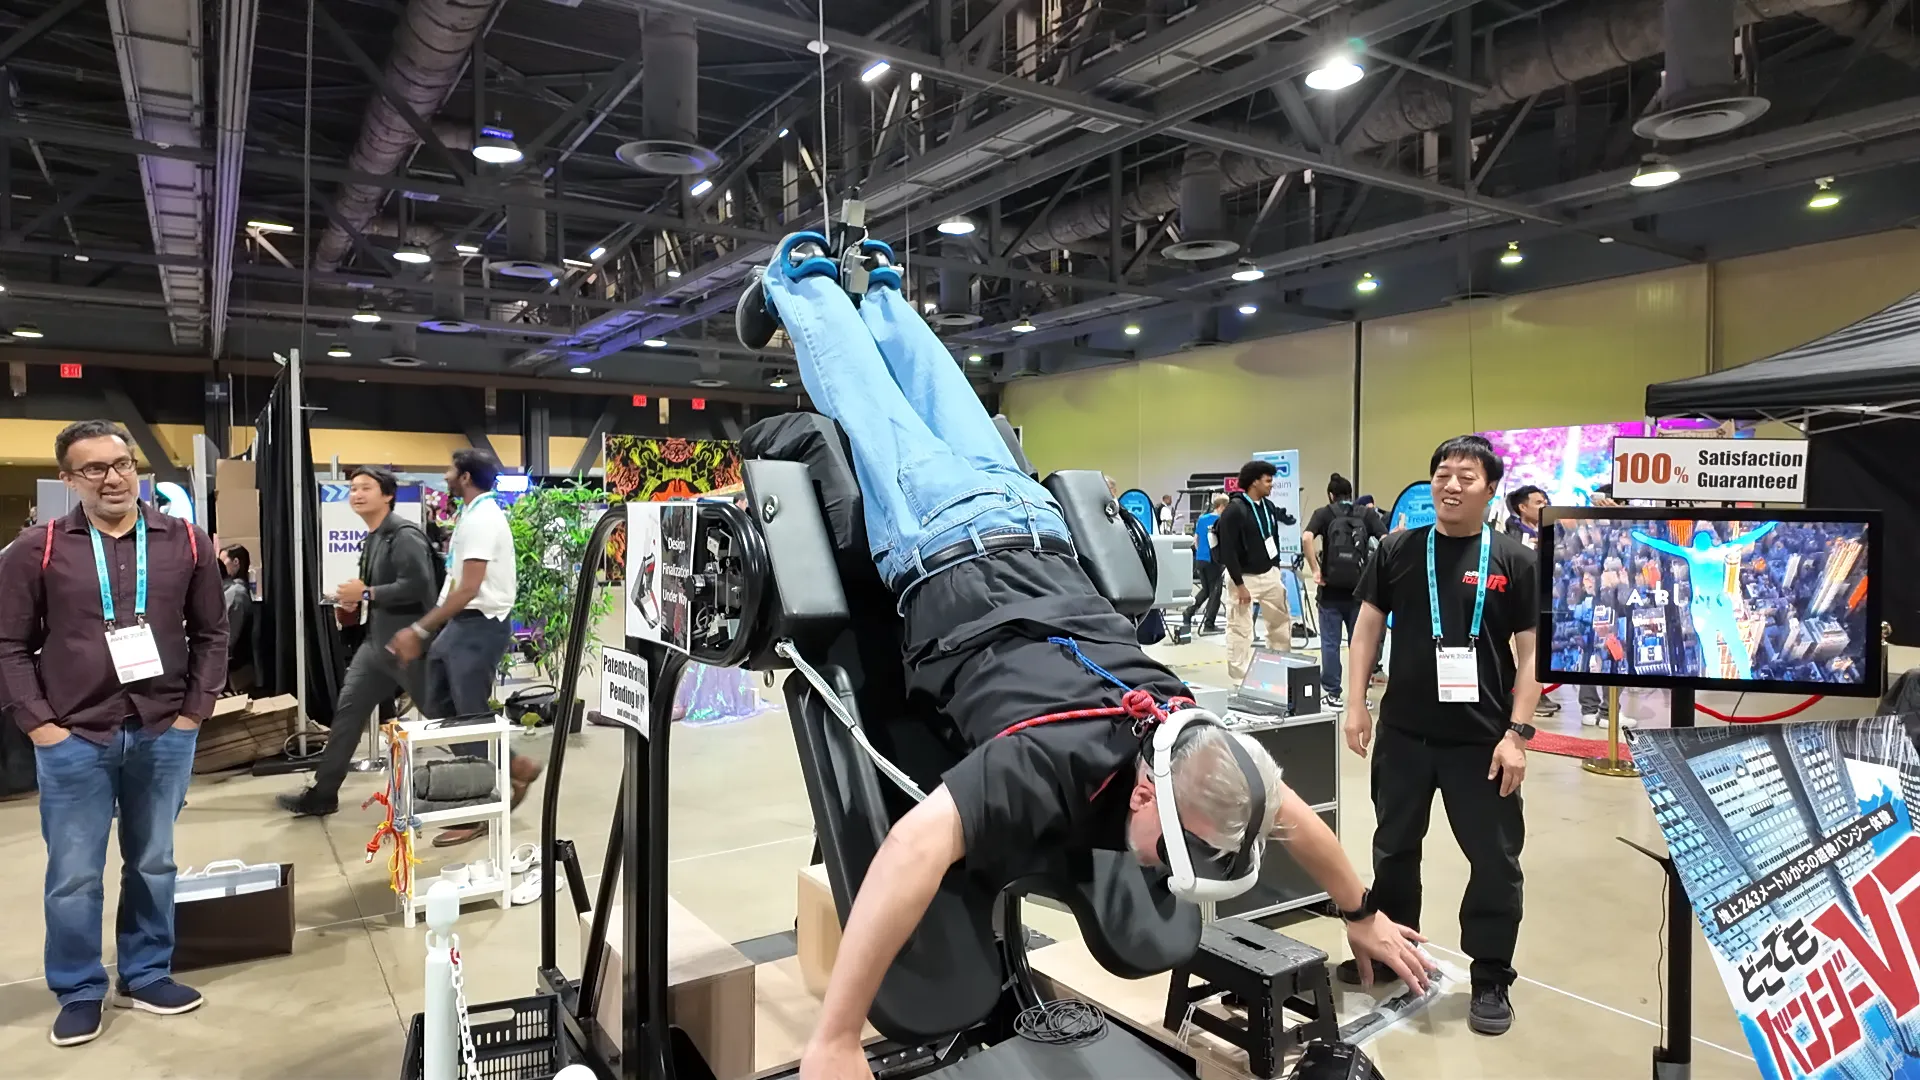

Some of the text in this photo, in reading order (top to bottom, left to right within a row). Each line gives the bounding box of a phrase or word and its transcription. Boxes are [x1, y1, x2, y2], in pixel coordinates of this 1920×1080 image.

[1698, 450, 1803, 467] Satisfaction
[1615, 452, 1689, 484] 100%
[1697, 472, 1798, 489] Guaranteed
[329, 543, 363, 553] IMM
[667, 537, 686, 553] Design
[662, 562, 690, 578] Finalization
[662, 588, 678, 603] Under
[603, 654, 627, 678] Patents
[609, 681, 634, 709] Pending
[1737, 917, 1819, 1003] どこでも
